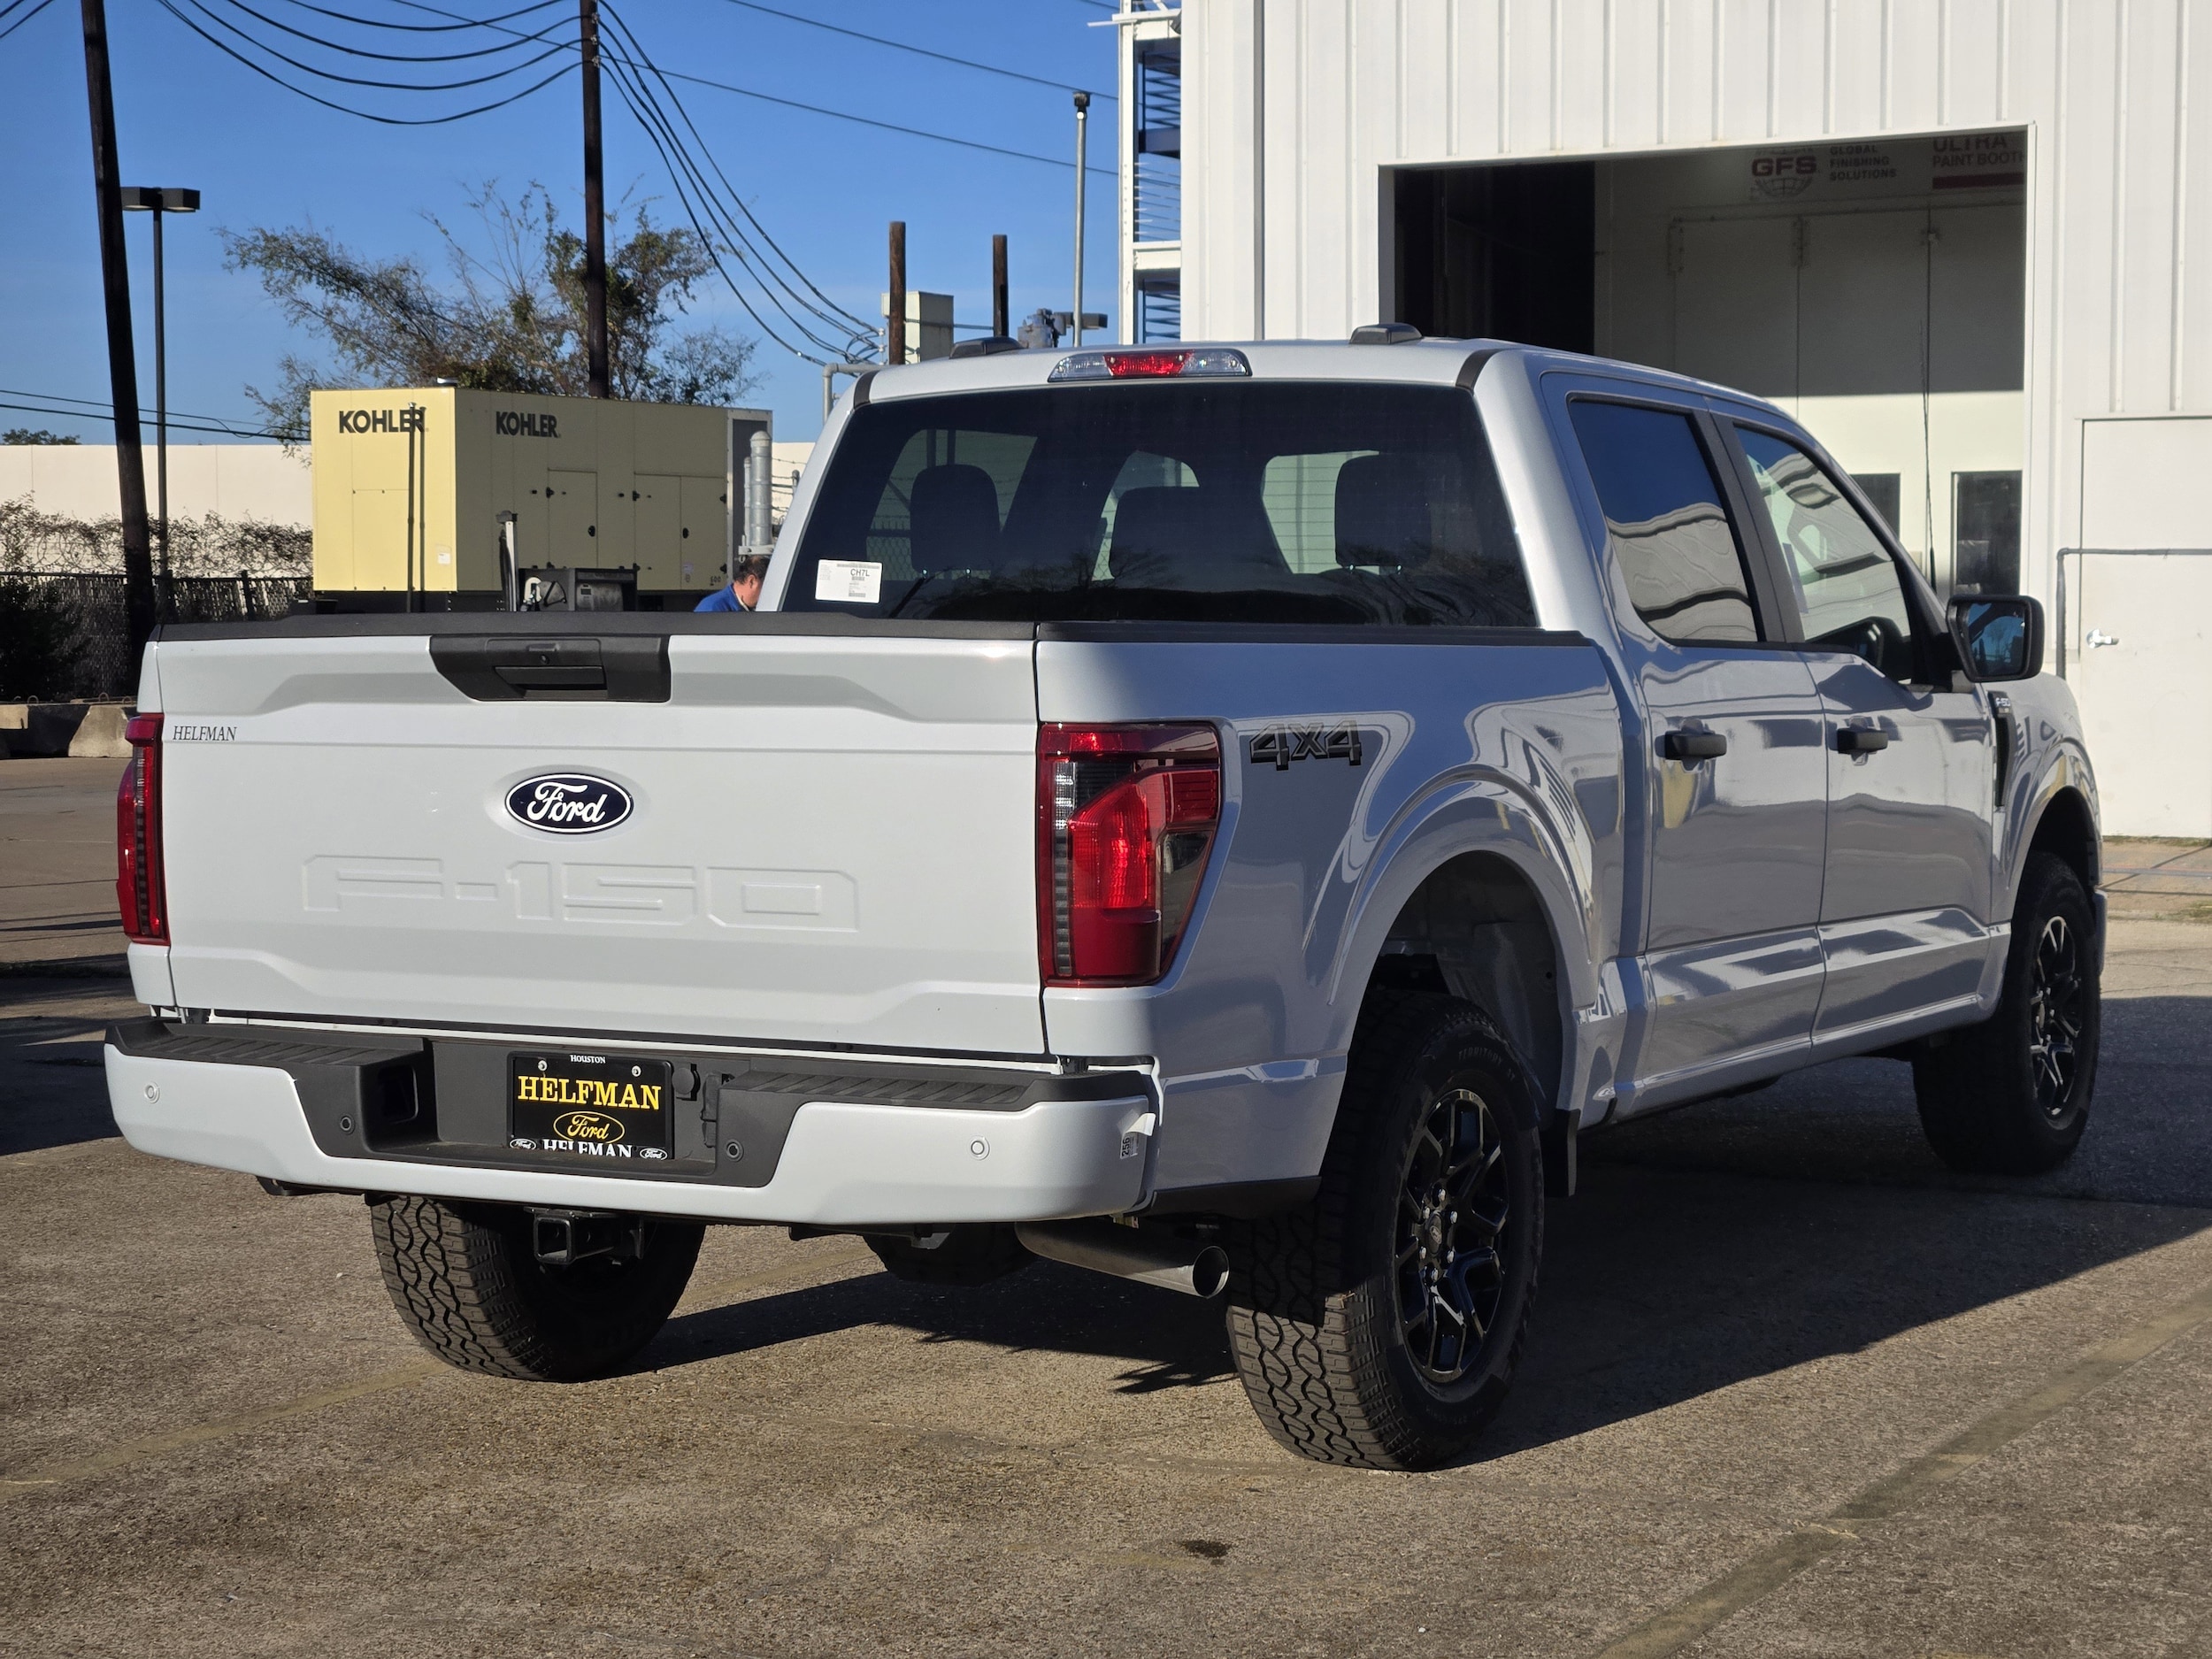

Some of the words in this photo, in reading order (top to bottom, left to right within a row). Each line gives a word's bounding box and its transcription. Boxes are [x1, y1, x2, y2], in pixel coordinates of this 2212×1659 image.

[1830, 145, 1878, 156] GLOBAL
[1752, 155, 1817, 177] GFS
[1830, 156, 1890, 167] FINISHING
[1932, 154, 1974, 168] PAINT
[1830, 167, 1897, 180] SOLUTIONS
[339, 410, 425, 434] KOHLER
[495, 411, 558, 438] KOHLER
[850, 568, 871, 577] CH7L
[173, 726, 237, 741] HELFMAN
[526, 781, 608, 824] Ford
[302, 854, 859, 933] F-150
[570, 1055, 606, 1064] HOUSTON
[518, 1075, 662, 1110] HELFMAN
[567, 1114, 611, 1140] Ford
[542, 1139, 633, 1158] HELFMAN
